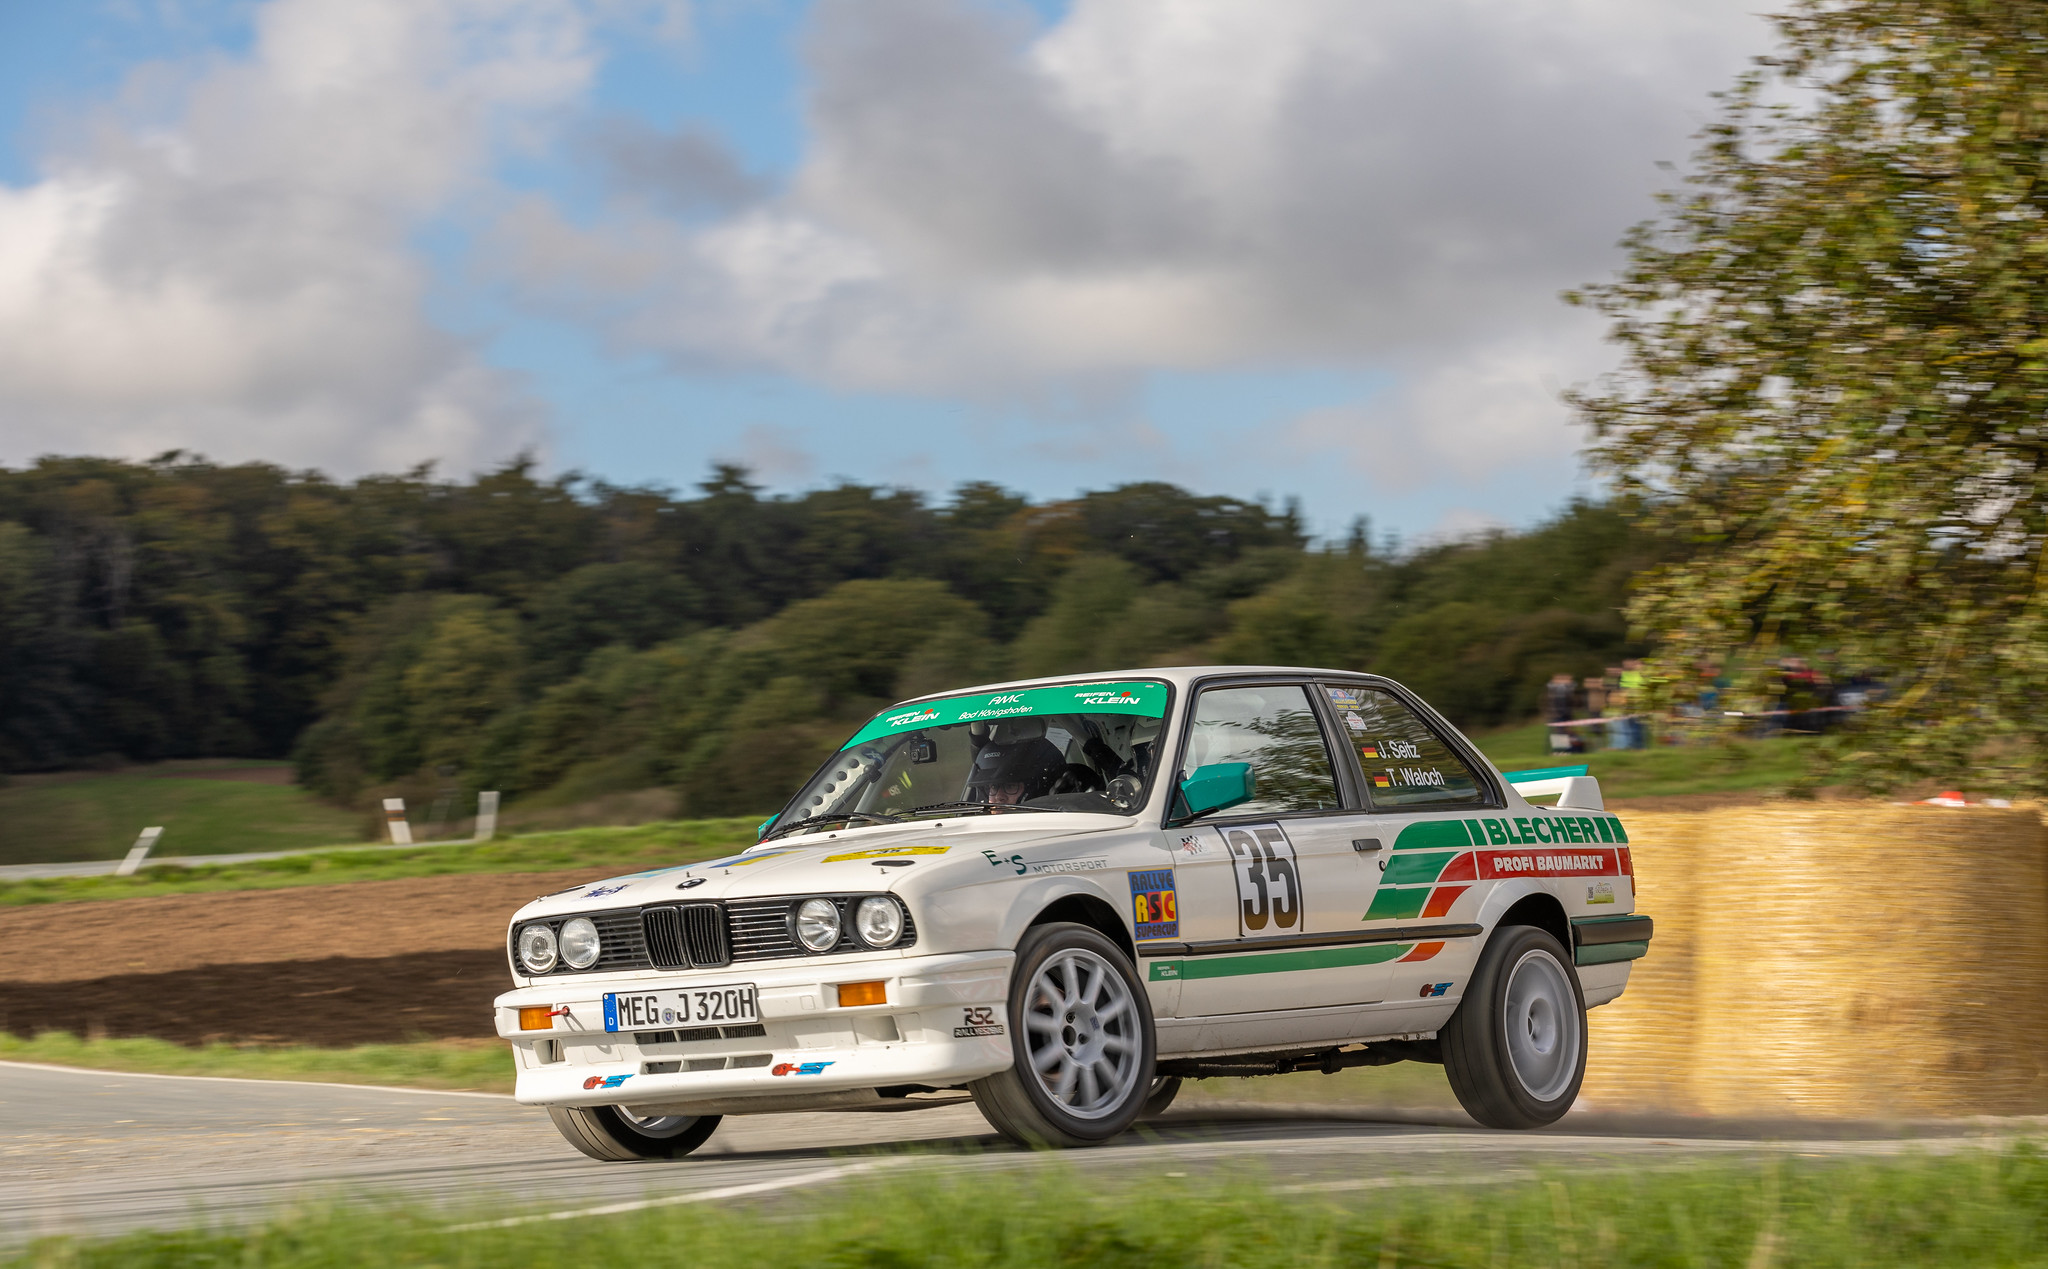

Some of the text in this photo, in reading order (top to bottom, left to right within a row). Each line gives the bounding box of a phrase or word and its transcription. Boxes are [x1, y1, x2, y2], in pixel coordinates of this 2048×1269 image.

[988, 693, 1025, 706] AMC
[1083, 697, 1141, 705] KLEIN
[891, 712, 940, 727] KLEIN
[958, 706, 1033, 720] Bad Königshofen
[1378, 740, 1421, 759] J. Seitz
[1385, 767, 1445, 787] T. Waloch
[1481, 817, 1600, 846] BLECHER
[1033, 859, 1108, 874] MOTORSPORT
[1493, 855, 1604, 872] PROFI BAUMARKT
[1131, 871, 1174, 892] RALLYE
[1227, 828, 1298, 932] 35
[1134, 892, 1176, 923] RSC
[1136, 923, 1177, 939] SUPERCUP
[617, 988, 755, 1027] MEG J 320H
[608, 1017, 615, 1026] D
